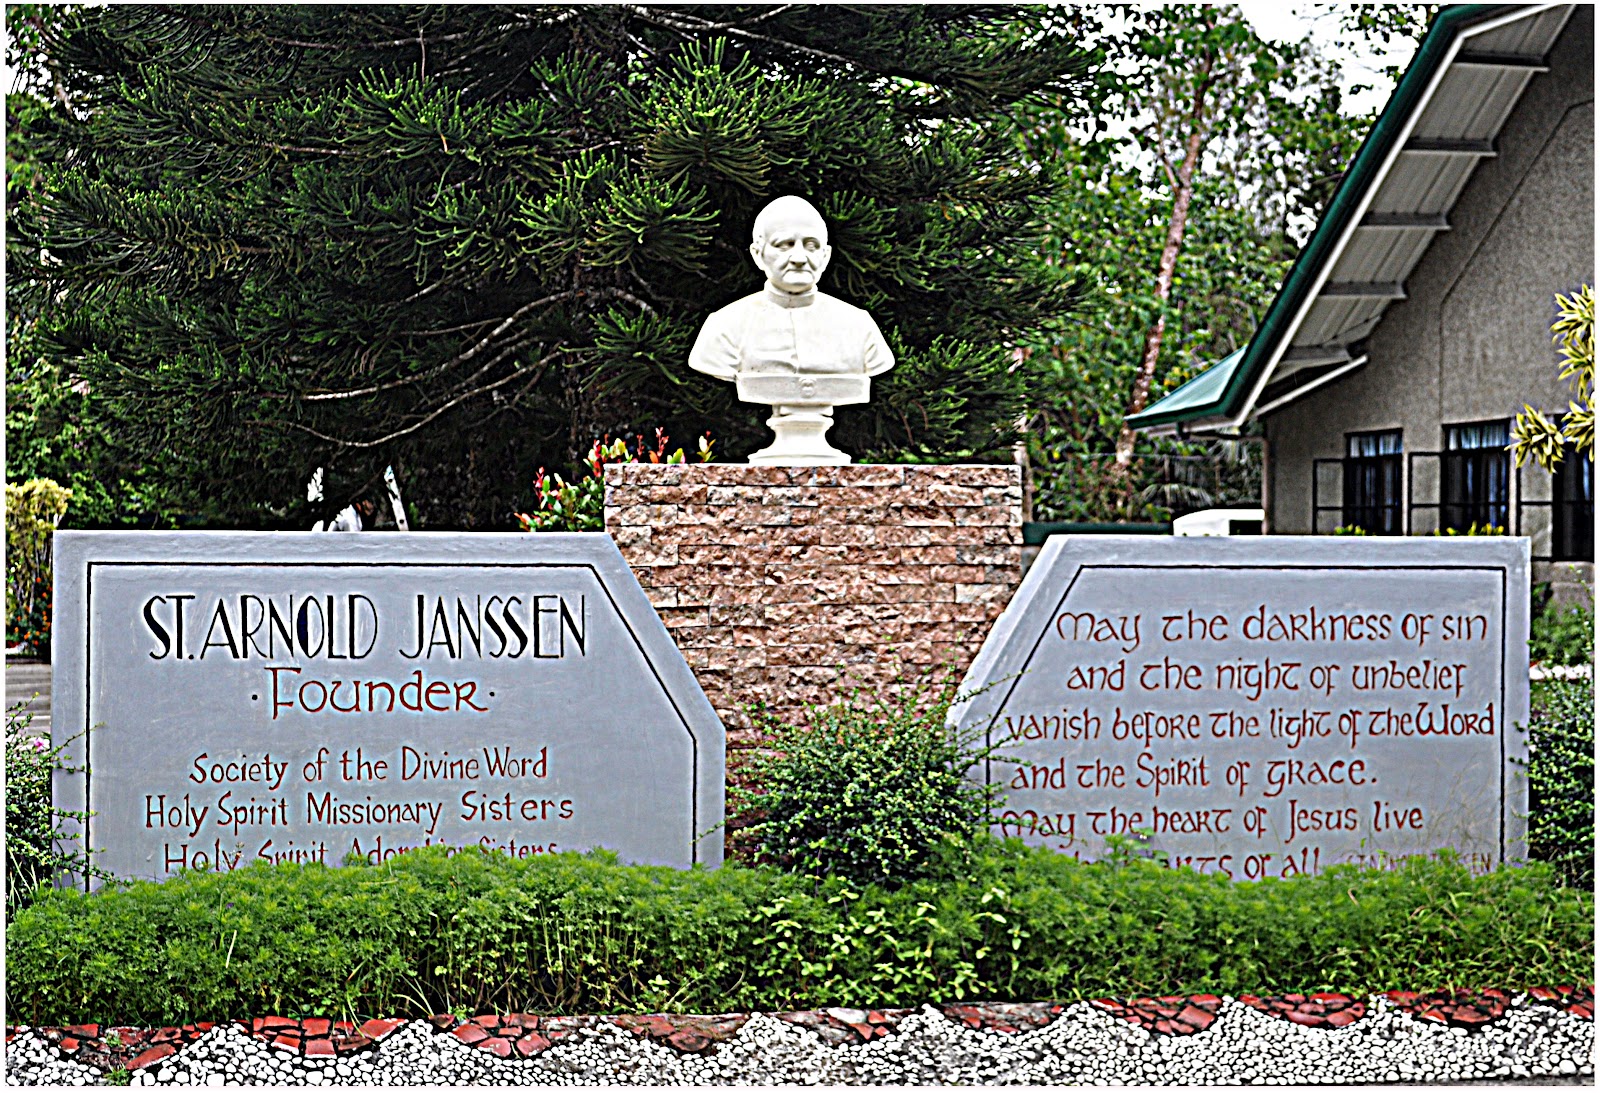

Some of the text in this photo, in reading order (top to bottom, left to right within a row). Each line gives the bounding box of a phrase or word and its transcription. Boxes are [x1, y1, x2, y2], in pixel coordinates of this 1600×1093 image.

[199, 594, 378, 660] ARNOLD
[398, 594, 586, 660] JANSSEN
[1056, 604, 1488, 654] May the darkness of sin
[264, 666, 490, 720] Founder
[1066, 655, 1467, 702] and the night of unbelief
[1006, 701, 1495, 749] vanish before the light of the Word
[188, 745, 548, 791] Society of the Divine Word
[1010, 751, 1378, 797] and the Spirit of grace.
[145, 789, 574, 838] Holy Spirit Missionary Sisters
[1001, 799, 1424, 849] May the heart of Jesus live
[1280, 846, 1320, 878] all
